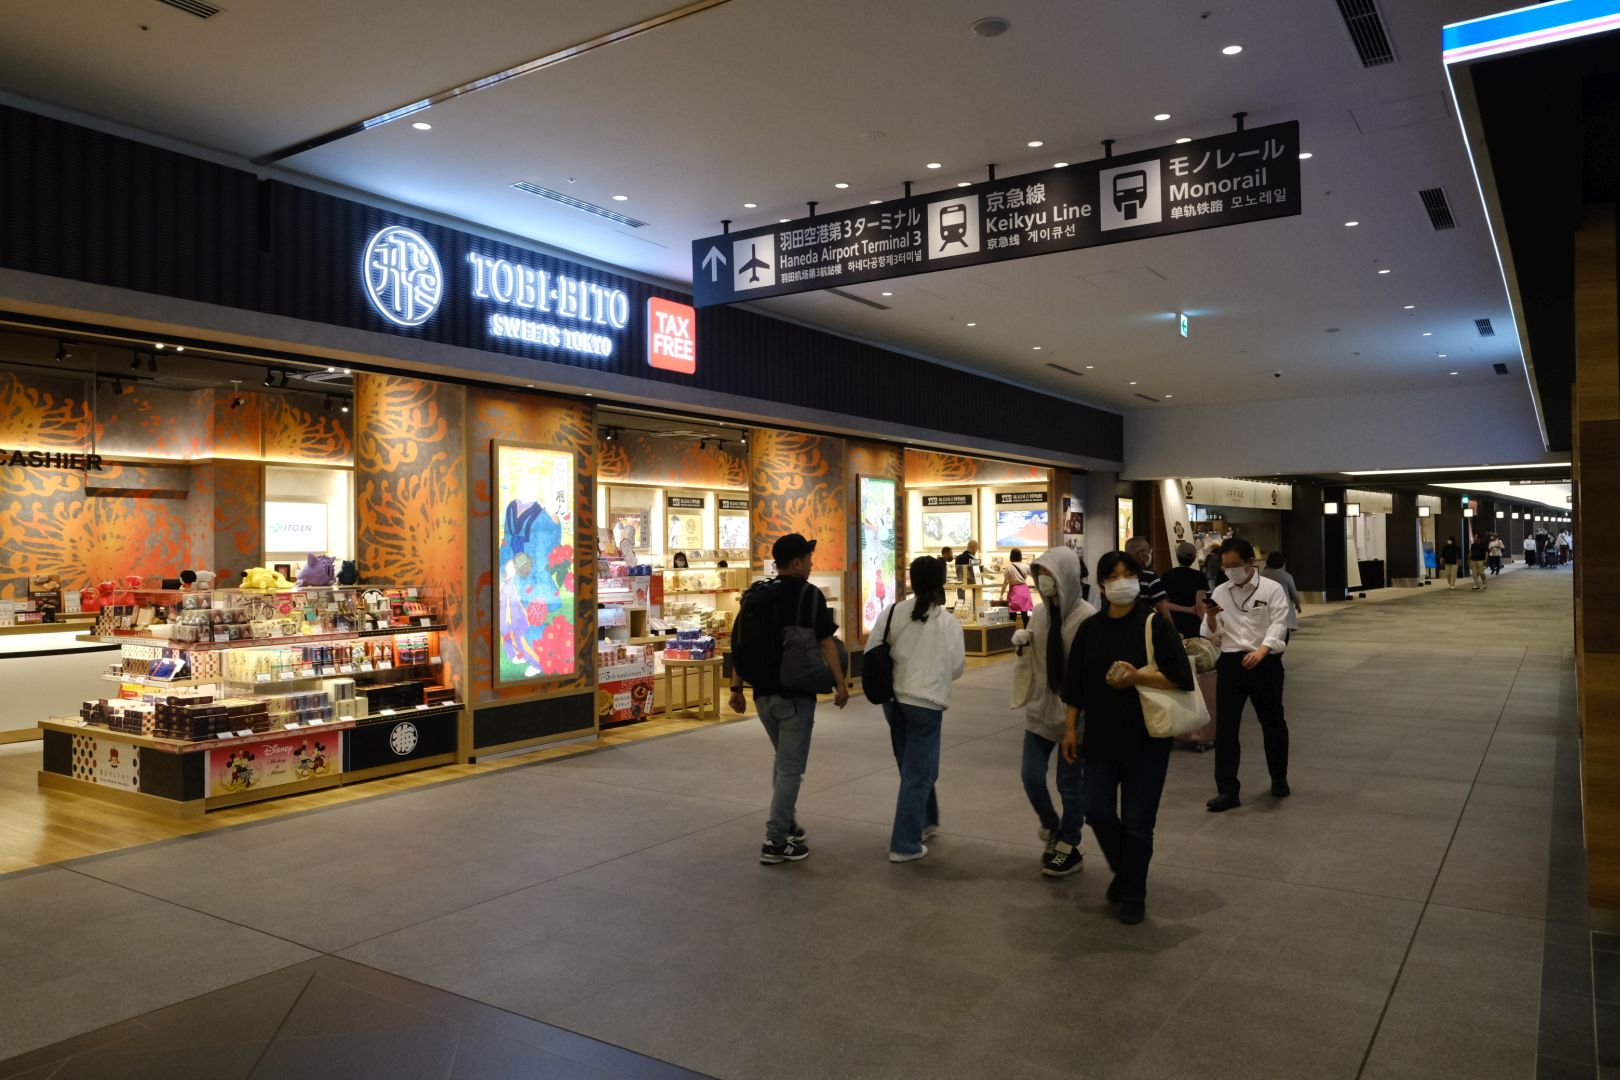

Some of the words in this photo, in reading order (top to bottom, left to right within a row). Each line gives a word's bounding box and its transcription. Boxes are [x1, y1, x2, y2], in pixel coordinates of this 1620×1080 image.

[1169, 138, 1284, 177] モノレール
[986, 183, 1045, 211] 京急線
[1170, 167, 1267, 201] Monorail
[1171, 200, 1223, 220] 单轨铁路
[1231, 188, 1287, 209] 모노레일
[986, 211, 1046, 234] Keikyu
[1054, 202, 1092, 222] Line
[987, 234, 1020, 249] 京急线
[1028, 225, 1076, 243] 게이큐선
[780, 249, 818, 269] Haneda
[821, 241, 860, 262] Airport
[862, 234, 910, 253] Terminal
[913, 231, 921, 246] 3
[491, 314, 560, 347] SWEETS
[564, 328, 612, 356] TOKYO
[655, 312, 688, 335] TAX
[653, 333, 693, 361] FREE
[262, 744, 293, 756] Disney
